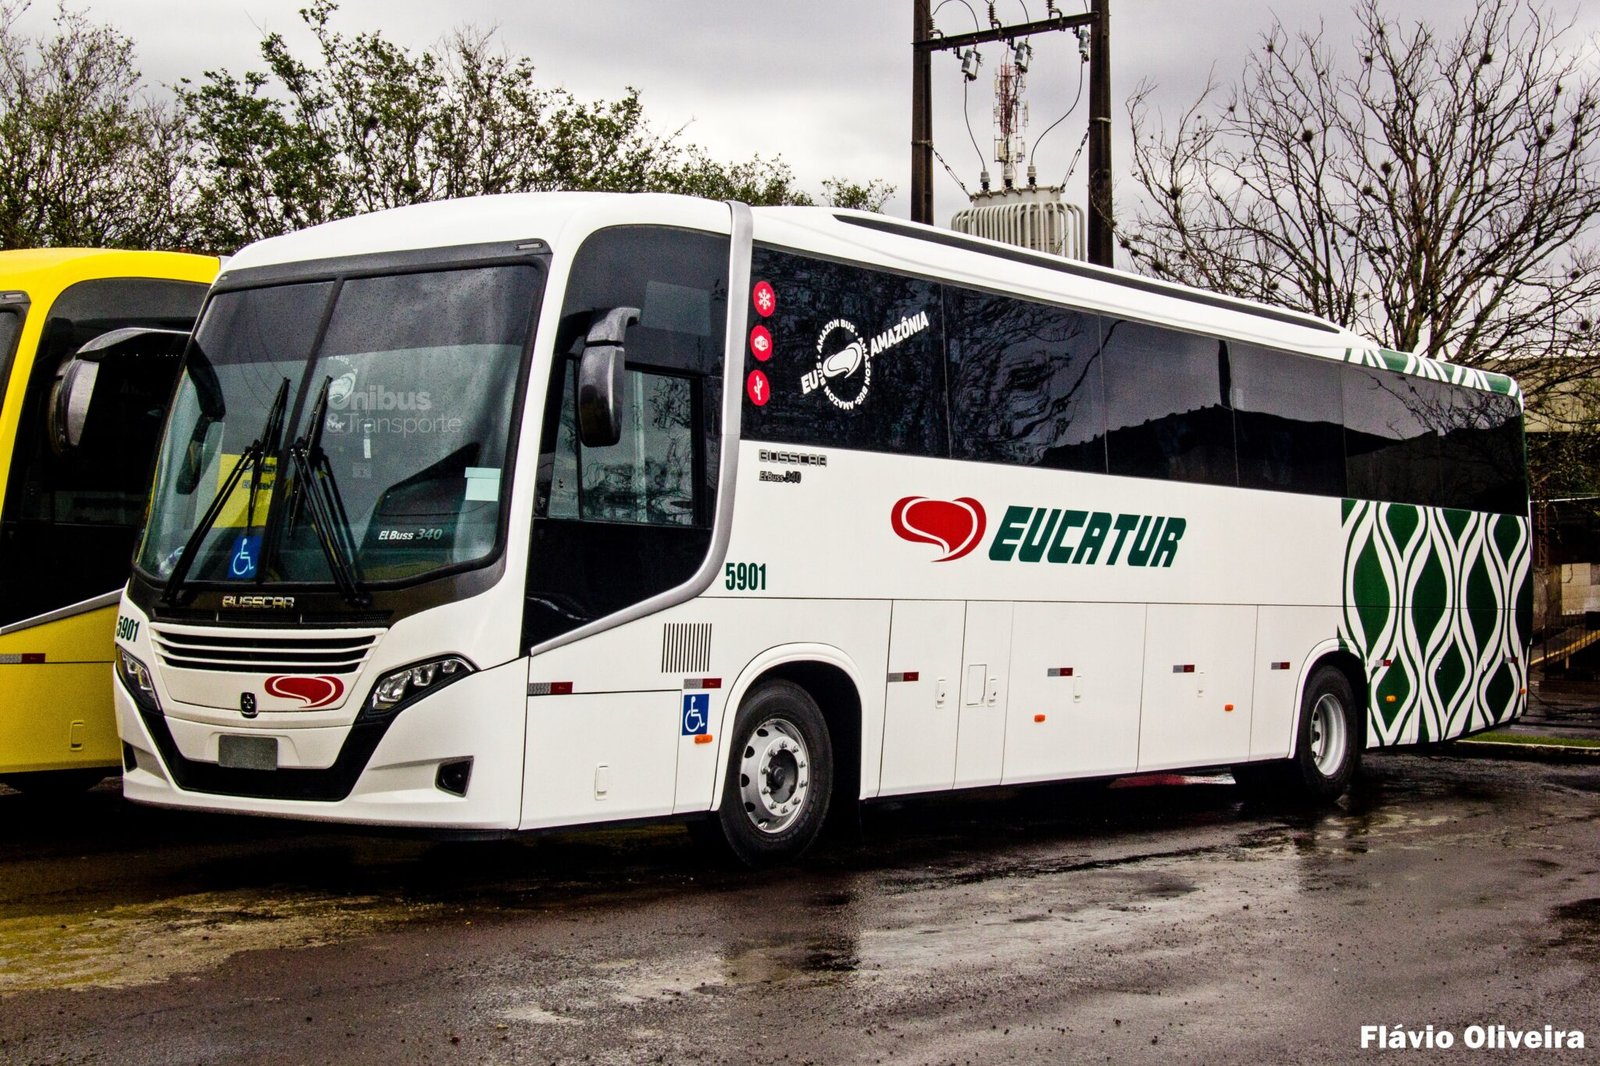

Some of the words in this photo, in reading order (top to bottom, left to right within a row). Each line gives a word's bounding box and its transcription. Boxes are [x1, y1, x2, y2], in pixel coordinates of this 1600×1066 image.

[816, 318, 840, 354] AMAZON
[840, 318, 856, 334] BUS
[800, 369, 819, 395] EU
[870, 310, 930, 358] AMAZÔNIA
[855, 385, 869, 405] BUS
[759, 448, 828, 468] BUSSCAR
[784, 470, 802, 484] 340
[415, 528, 443, 540] 340
[988, 505, 1187, 568] EUCATUR
[725, 562, 767, 591] 5901
[222, 595, 295, 609] BUSSCAR
[116, 615, 140, 643] 5901
